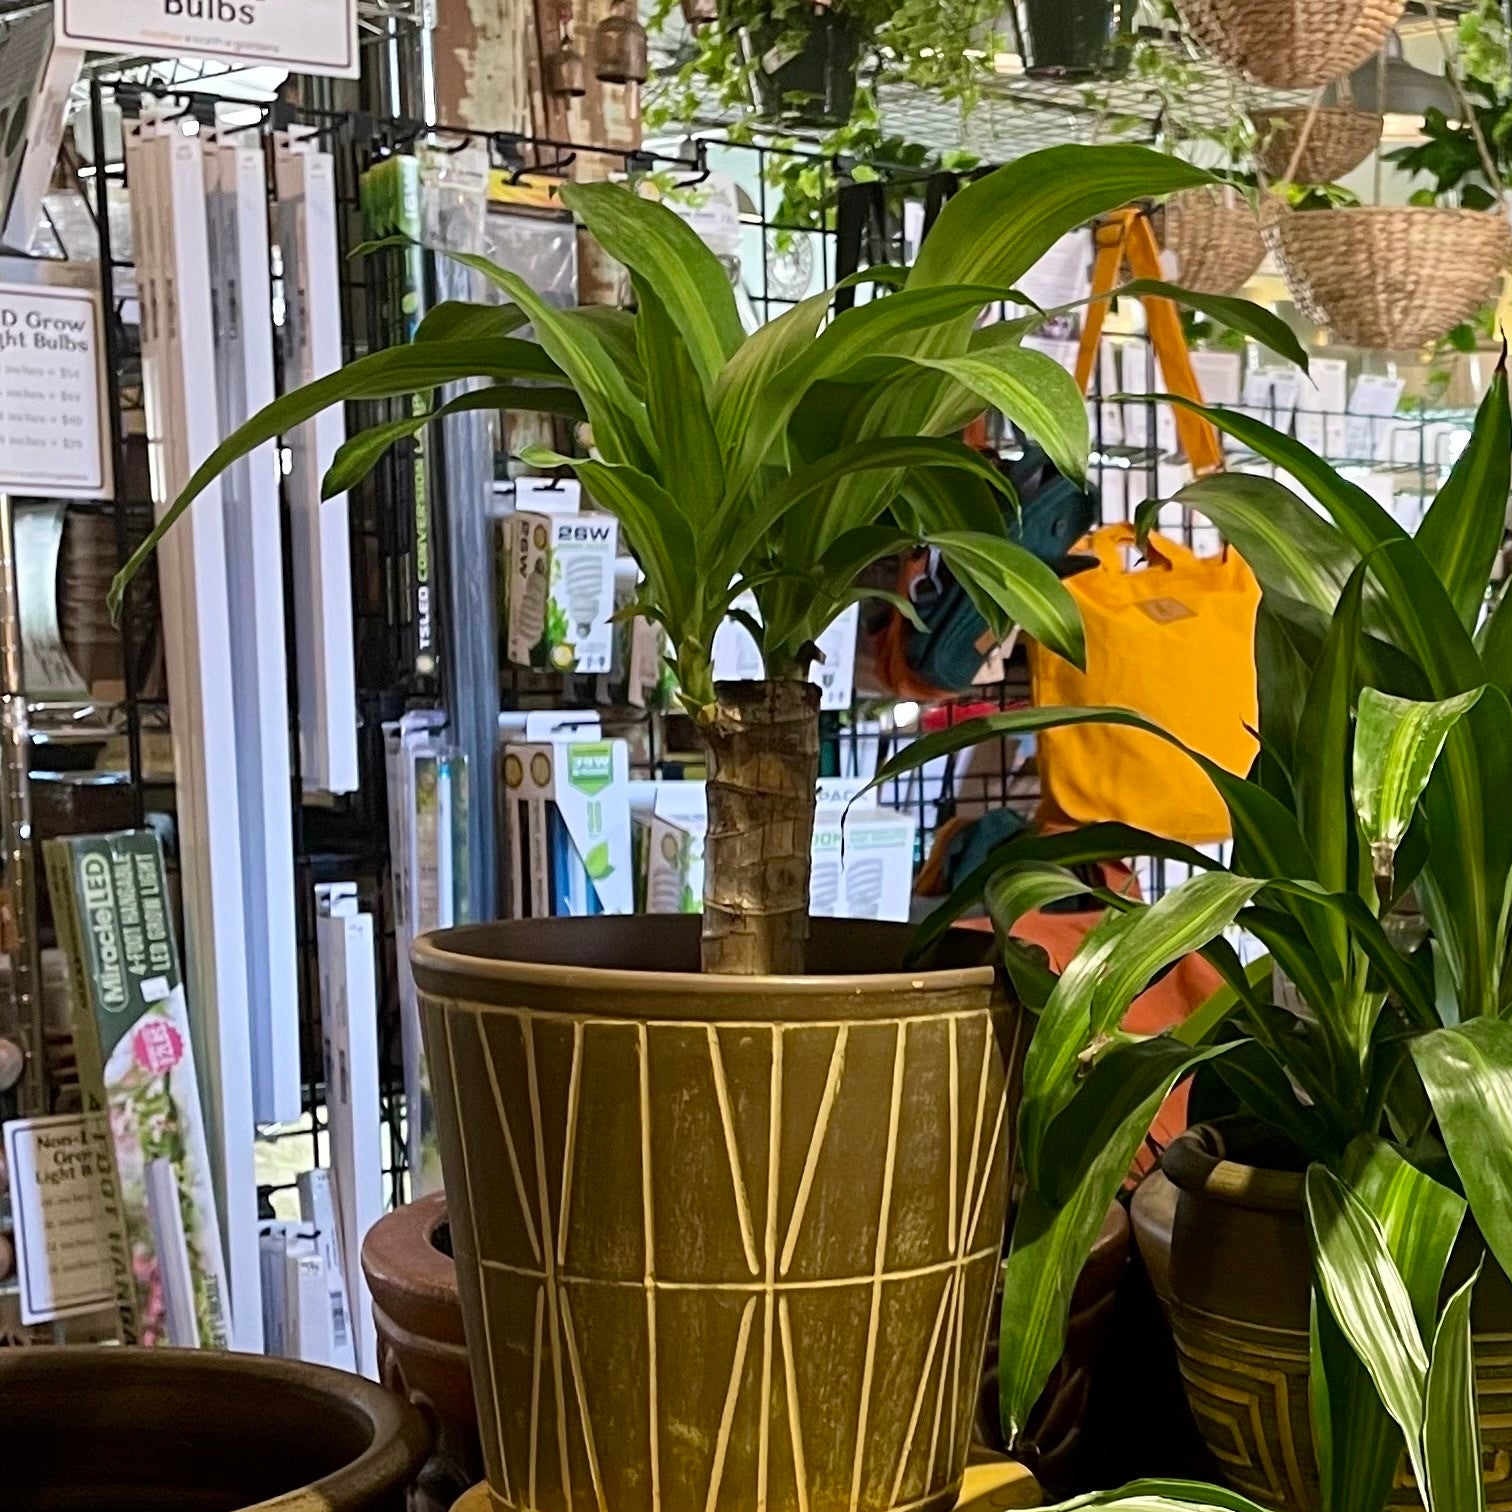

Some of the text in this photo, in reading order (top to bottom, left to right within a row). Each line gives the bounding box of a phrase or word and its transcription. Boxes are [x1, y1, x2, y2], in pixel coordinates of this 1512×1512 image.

[165, 0, 254, 25] Bulbs
[26, 311, 86, 334] Grow
[34, 332, 89, 353] Bulbs
[414, 458, 428, 582] CONVERSION
[558, 526, 610, 541] 26W
[135, 853, 172, 972] LED GROW LIGHT
